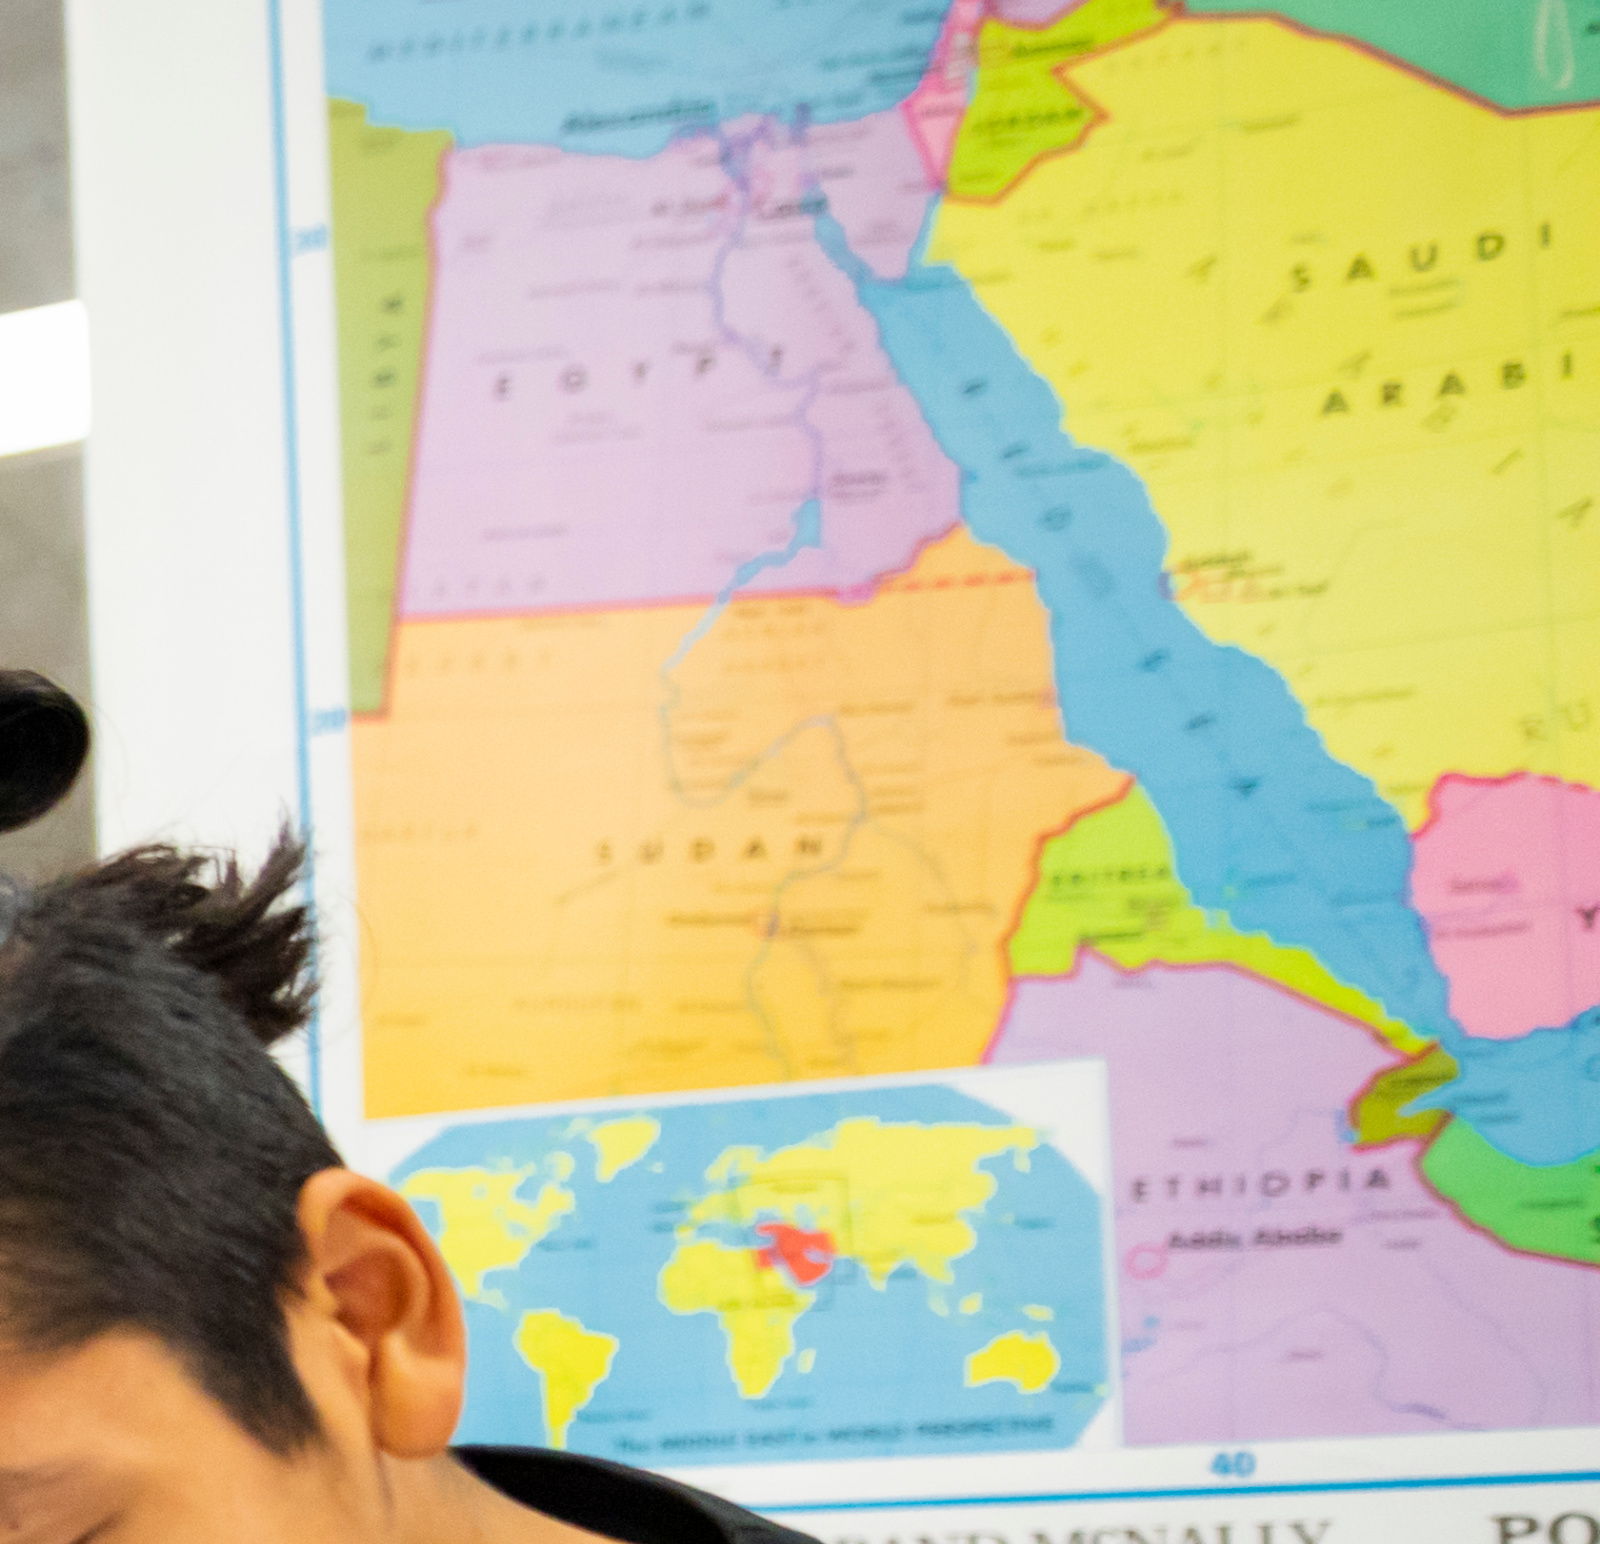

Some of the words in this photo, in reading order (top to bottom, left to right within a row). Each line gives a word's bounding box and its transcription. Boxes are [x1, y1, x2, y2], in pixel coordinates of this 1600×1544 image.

[1289, 221, 1552, 293] SAUDI
[494, 343, 787, 402] EGYPT
[594, 834, 827, 864] SUDAN
[1130, 1166, 1395, 1203] ETHIOPIA
